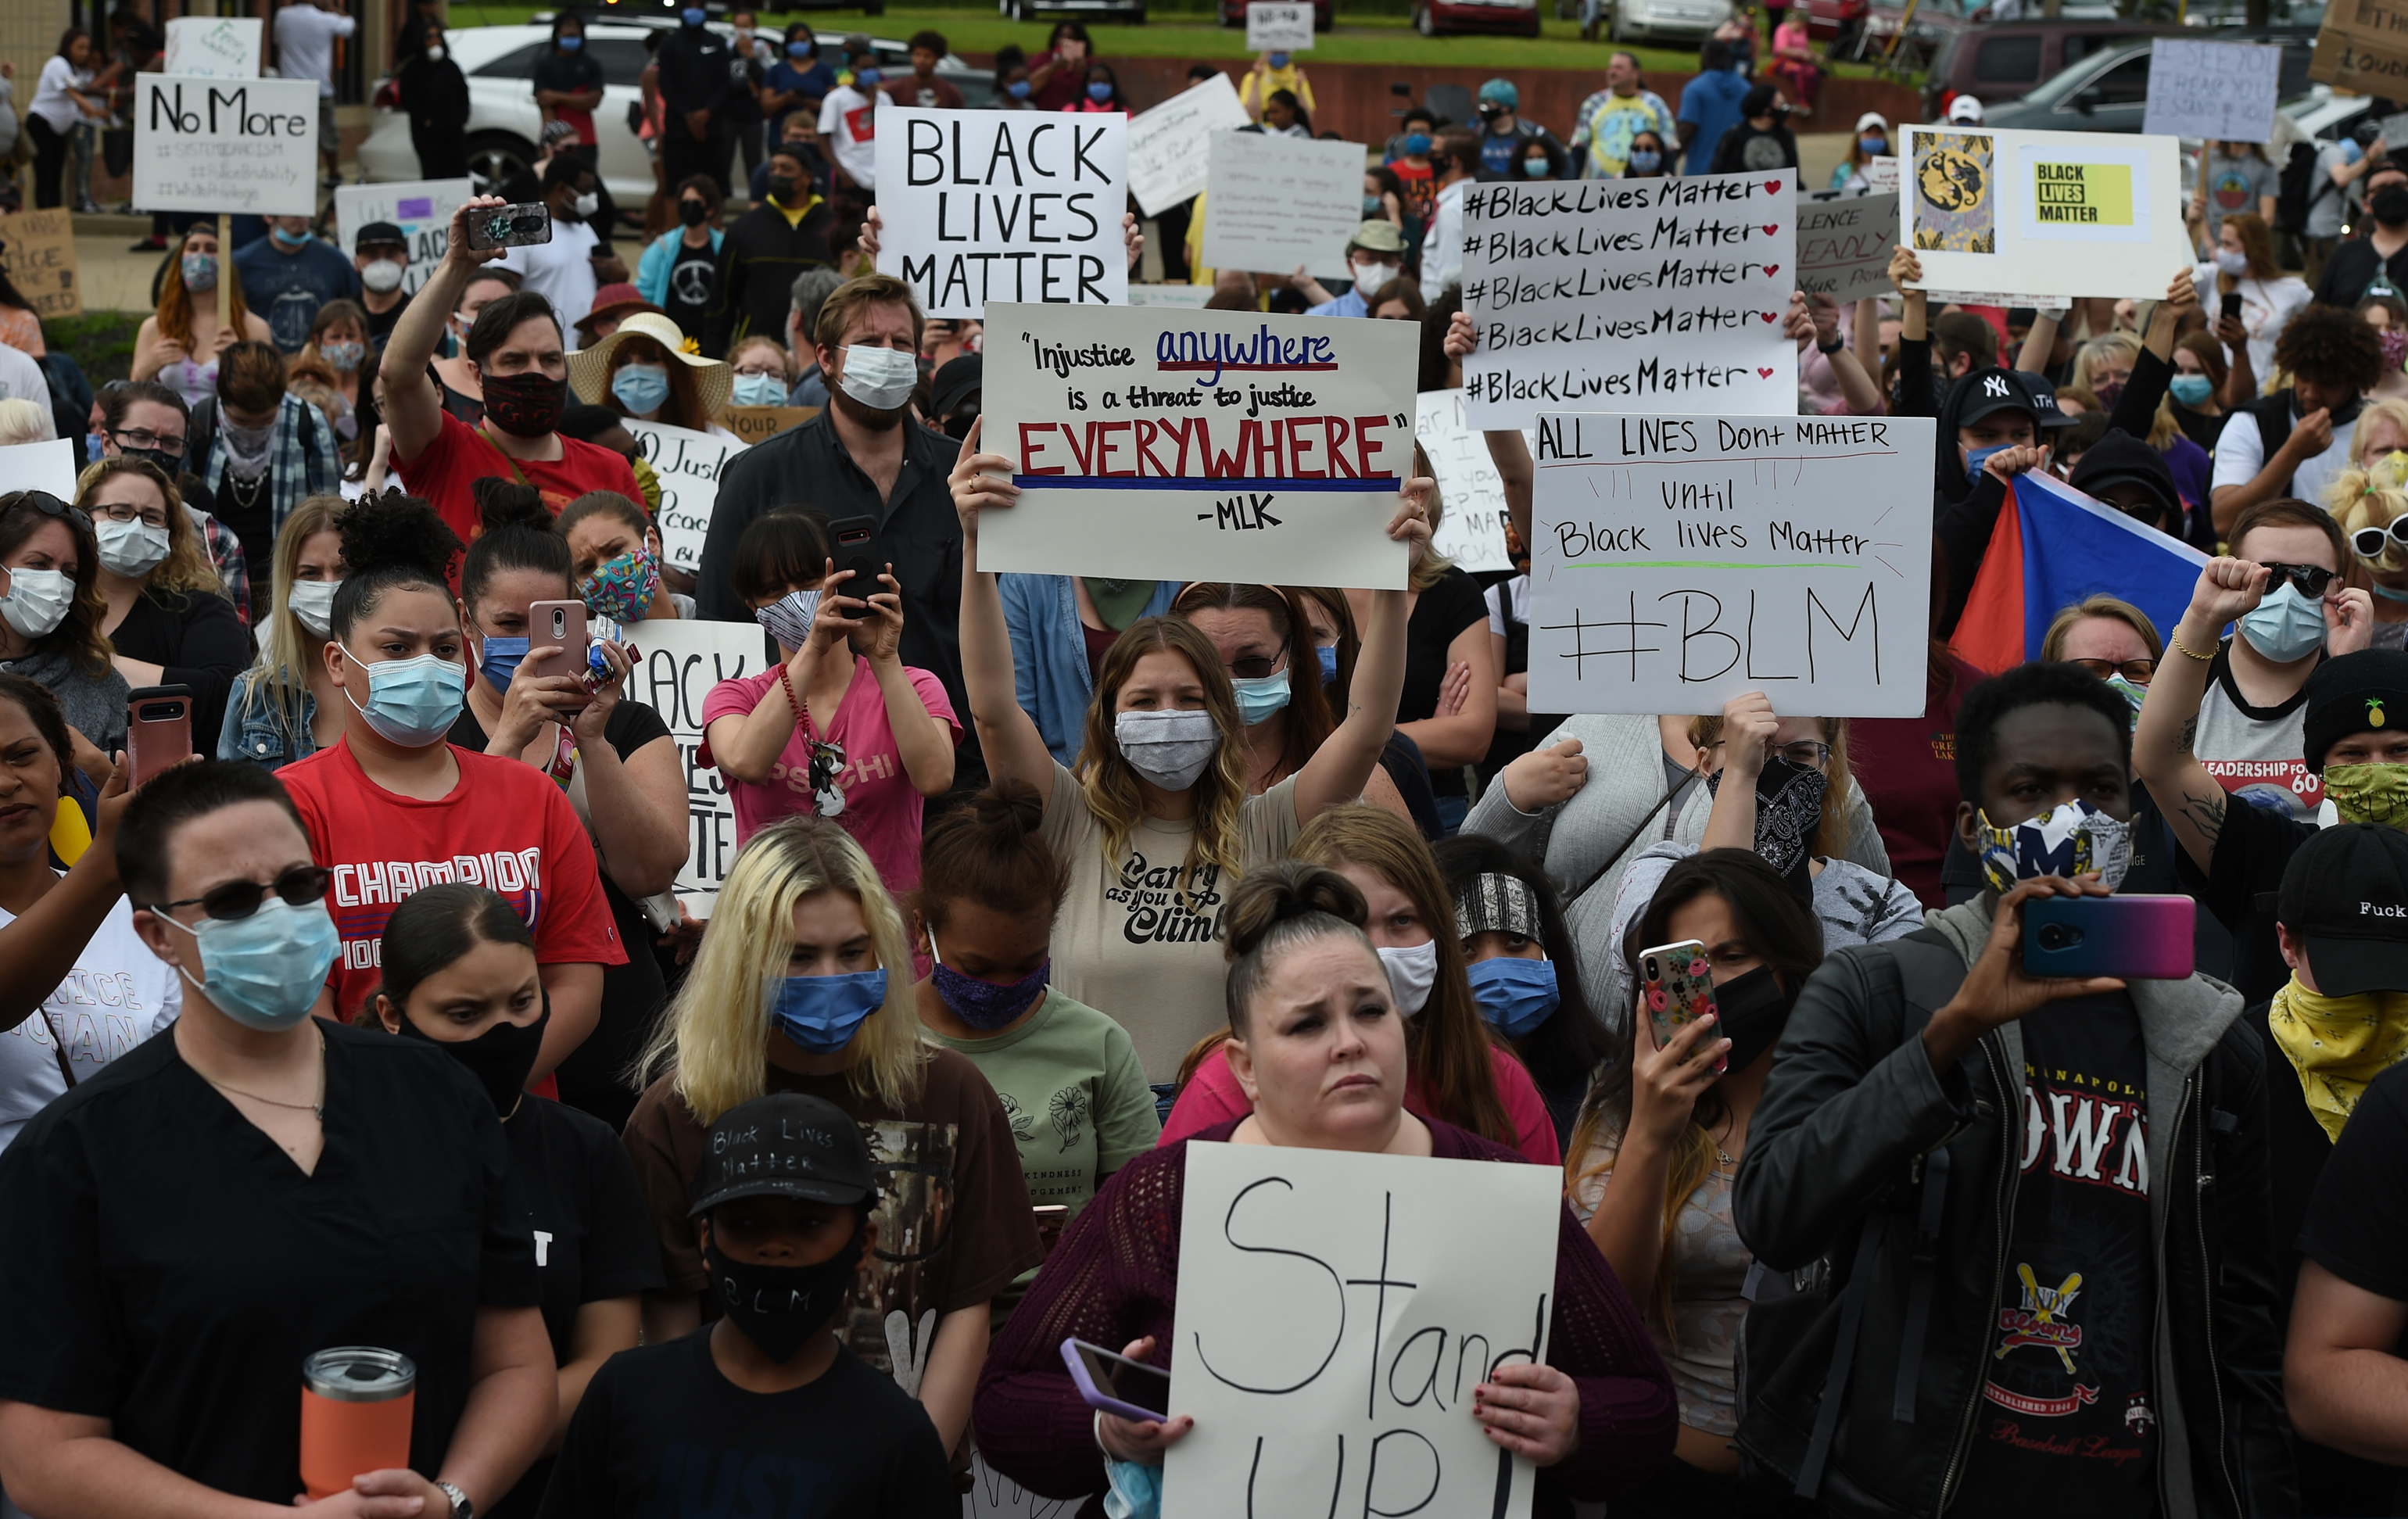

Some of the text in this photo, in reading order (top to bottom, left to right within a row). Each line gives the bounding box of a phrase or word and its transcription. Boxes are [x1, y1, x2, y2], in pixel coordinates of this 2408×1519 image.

[151, 82, 307, 138] No More
[905, 118, 1113, 188] BLACK
[2037, 164, 2084, 181] BLACK
[2041, 185, 2084, 202] LIVES
[937, 192, 1099, 244] LIVES
[1797, 209, 1864, 231] LENCE
[2039, 205, 2098, 223] MATTER
[1797, 227, 1894, 265] EADLY
[901, 253, 1110, 312] MATTER
[1156, 323, 1335, 388] anywhere
[1067, 382, 1317, 418] is a threat to justice
[1538, 417, 1593, 460] ALL
[1621, 417, 1698, 456] LIVES
[1718, 419, 1785, 452] Dont
[662, 436, 727, 482] Just
[1197, 493, 1283, 532] -MLK
[1553, 521, 1651, 558] Black
[1770, 521, 1870, 555] Matter
[1539, 581, 1881, 686] #BLM
[1931, 740, 1957, 751] GRE
[1934, 749, 1955, 761] LAK
[2290, 763, 2309, 776] FO
[332, 846, 542, 908] CHAMPION
[1120, 851, 1221, 908] Carry
[1105, 887, 1169, 912] as you
[2359, 901, 2407, 918] Fuck
[712, 1118, 833, 1155] Black Lives
[1023, 1169, 1082, 1180] KINDNESS
[1030, 1185, 1082, 1196] DGEMENT
[724, 1275, 812, 1314] BLM
